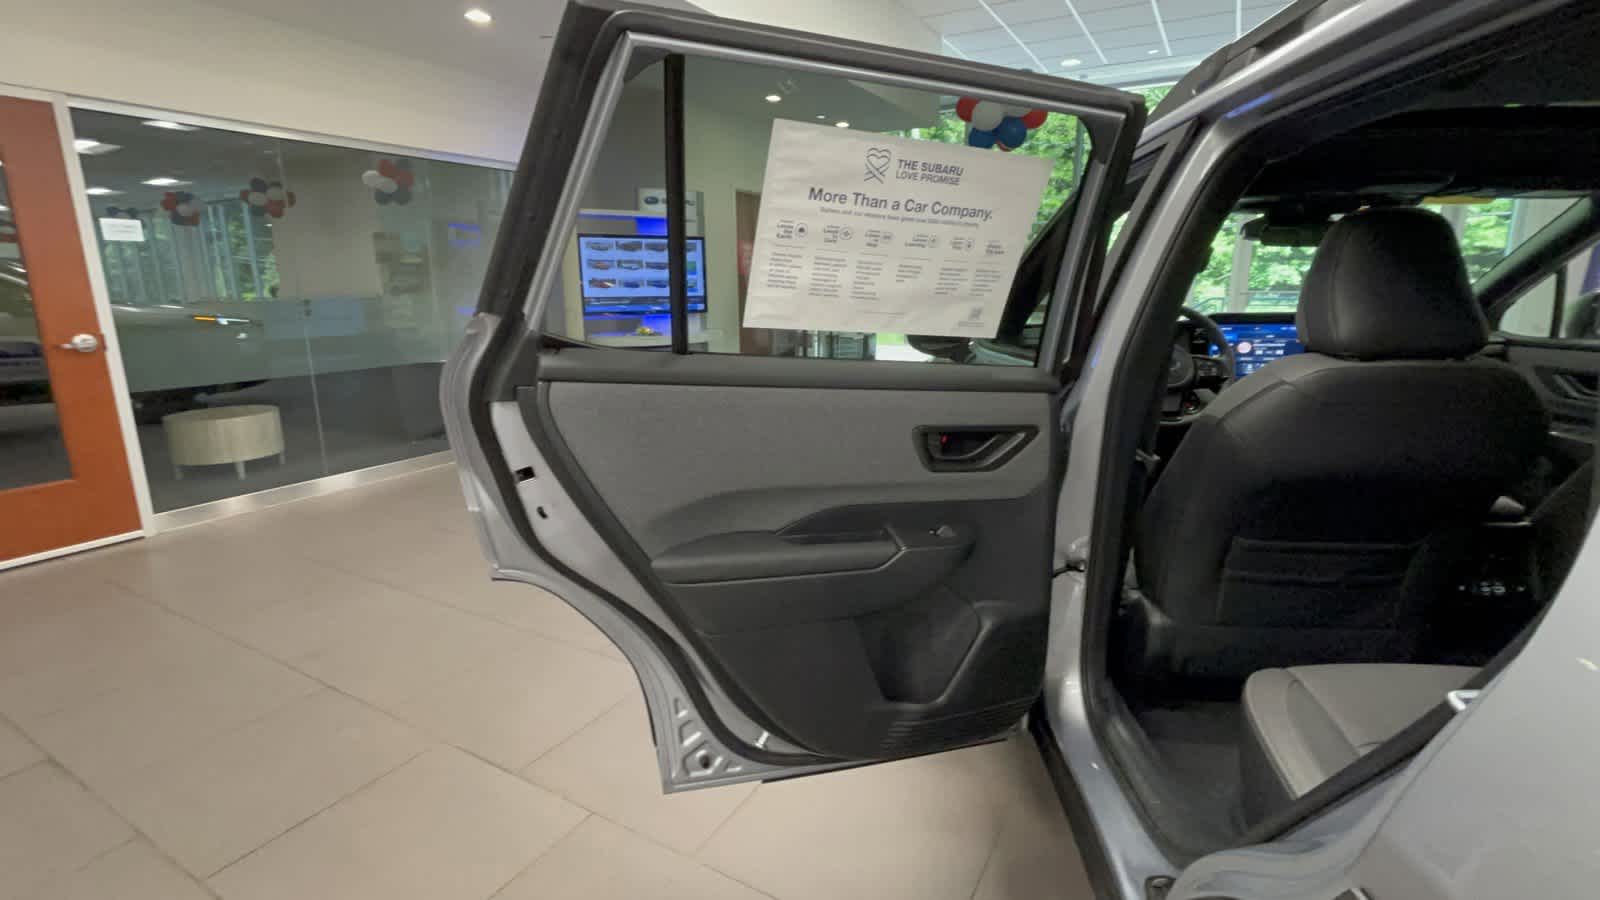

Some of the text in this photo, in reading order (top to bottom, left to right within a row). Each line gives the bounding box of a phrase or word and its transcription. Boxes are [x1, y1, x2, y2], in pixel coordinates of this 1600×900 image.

[897, 159, 964, 176] THE SUBARU
[896, 170, 961, 185] LOVE PROMISE
[808, 187, 847, 203] More
[852, 192, 888, 208] Than
[891, 202, 900, 210] a
[904, 199, 929, 213] Car
[931, 202, 993, 222] Company.
